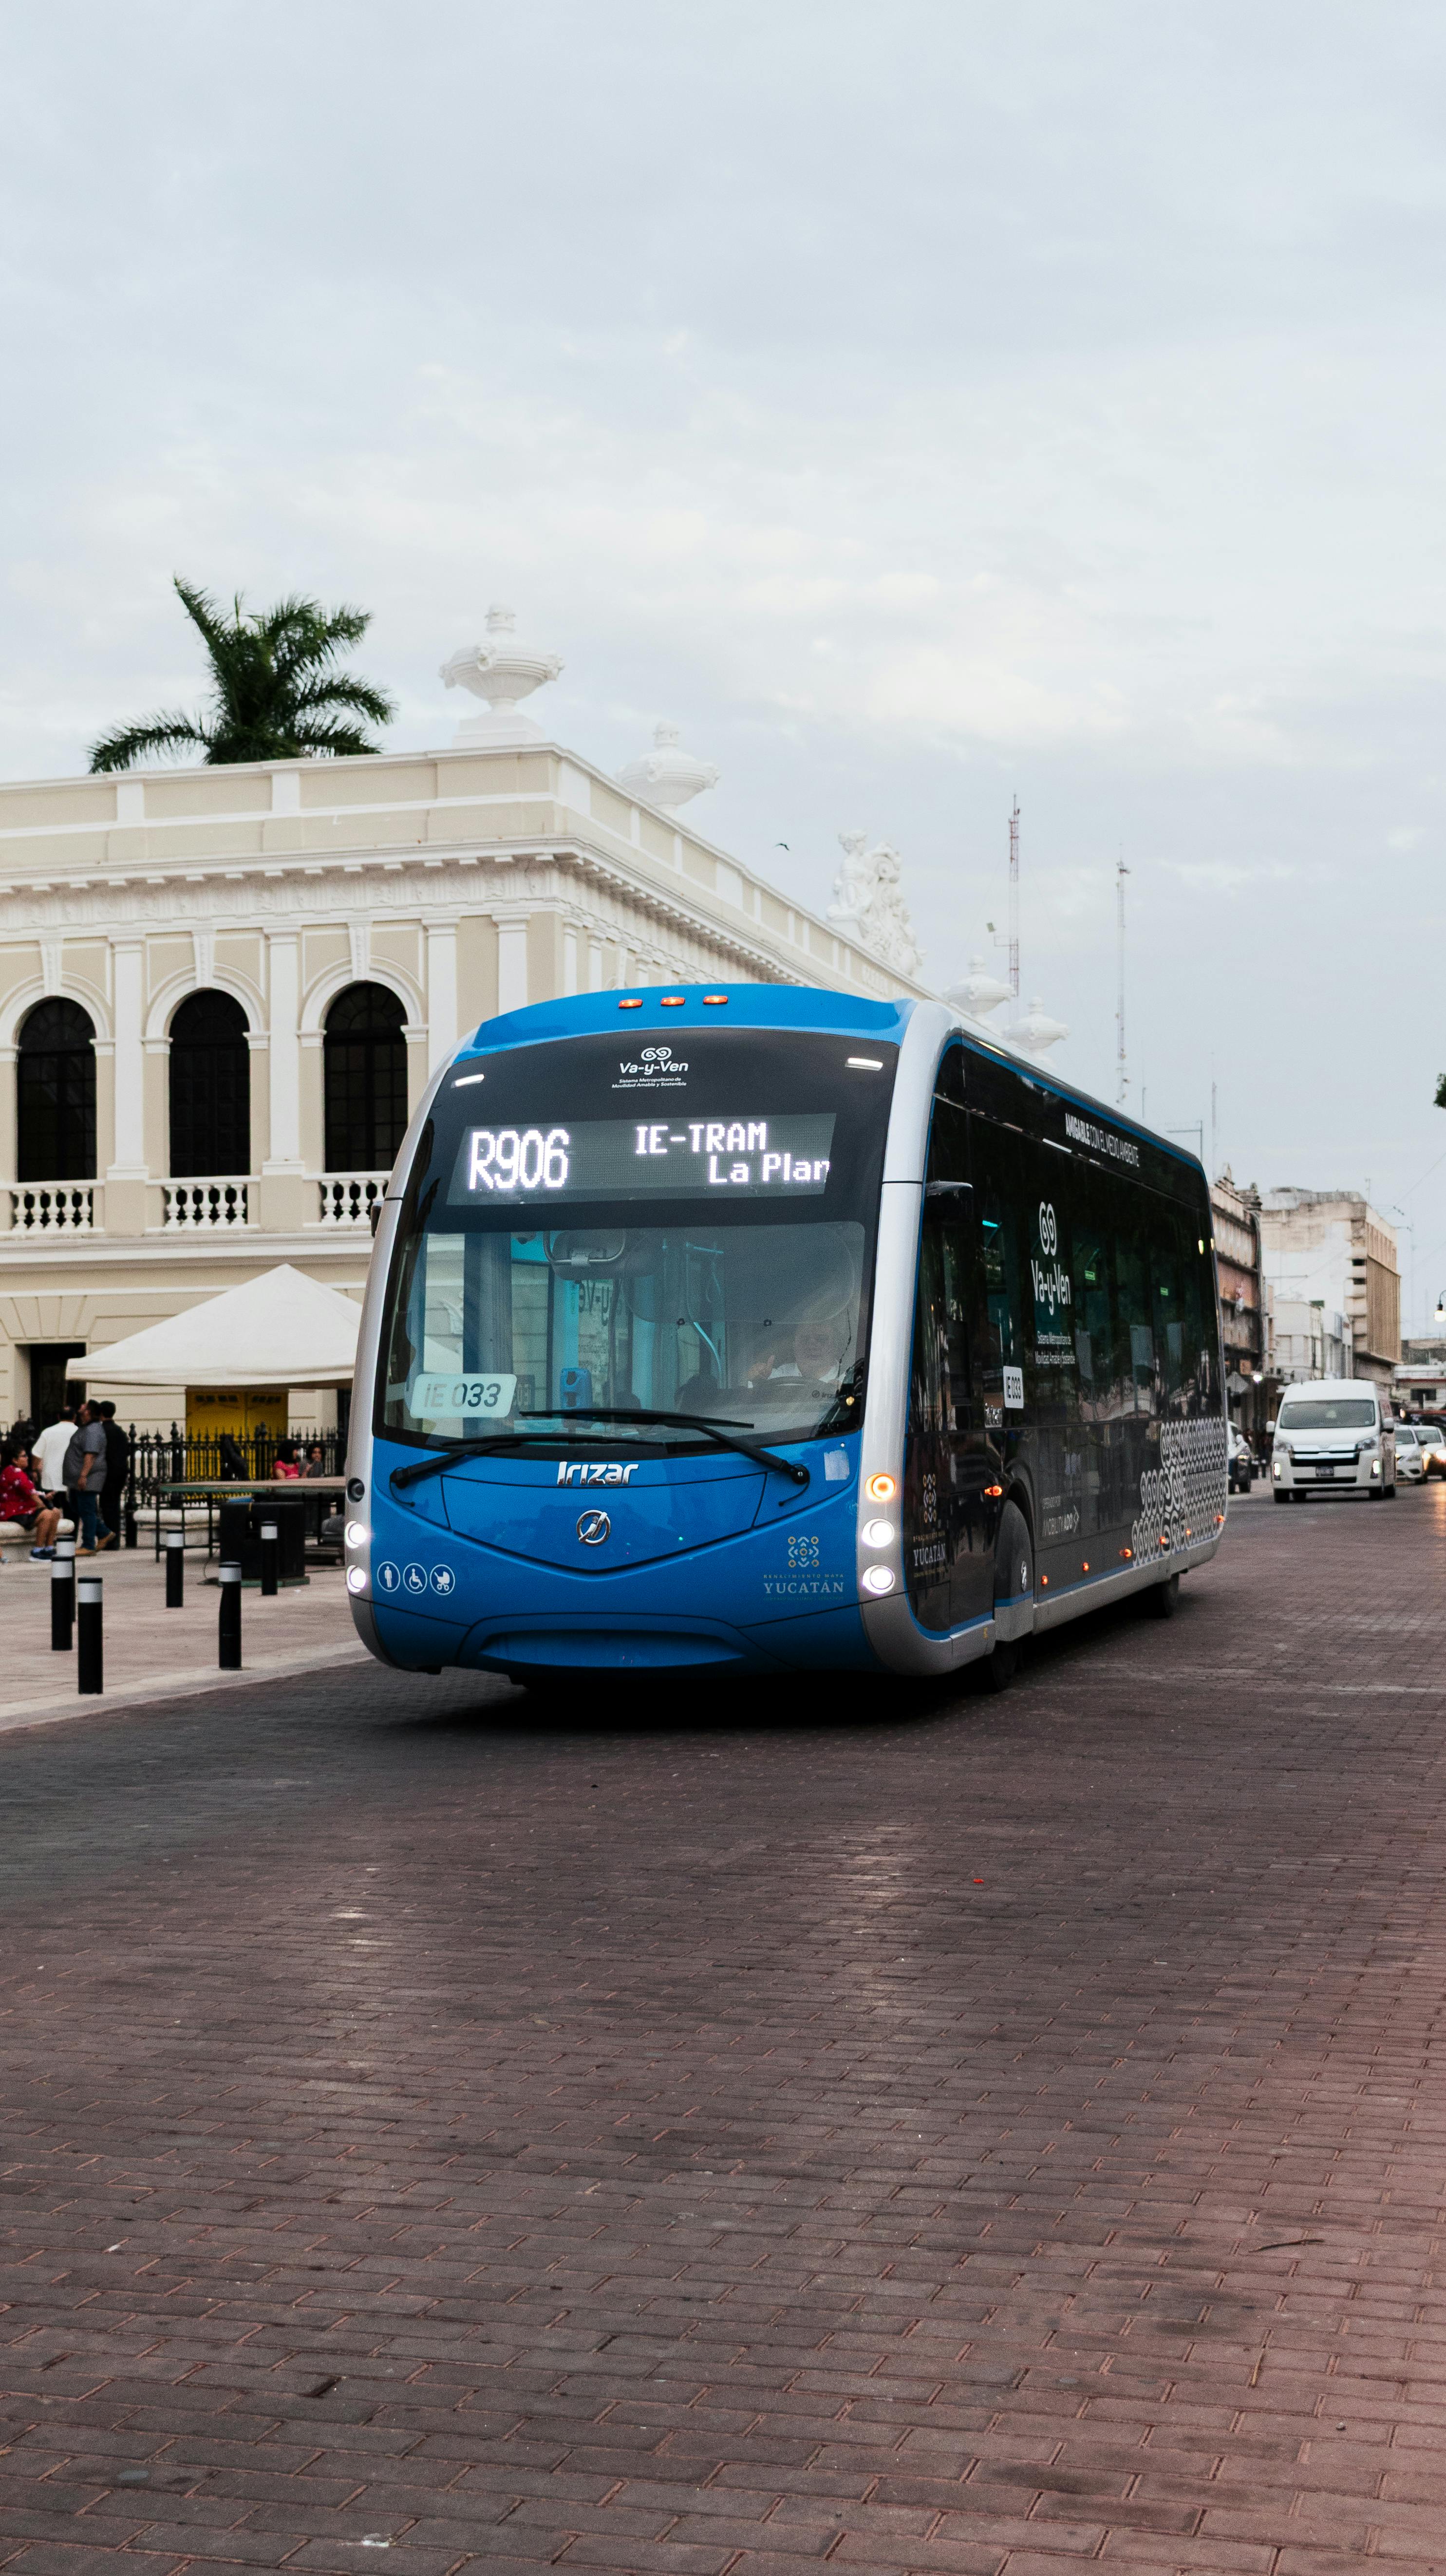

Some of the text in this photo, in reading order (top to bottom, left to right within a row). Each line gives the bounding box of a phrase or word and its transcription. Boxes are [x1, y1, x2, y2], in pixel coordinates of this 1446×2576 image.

[620, 1061, 689, 1075] Va-y-Ven
[636, 1122, 767, 1155] IE-TRAM
[469, 1129, 570, 1190] R906
[709, 1156, 749, 1183] La
[1031, 1259, 1071, 1316] Va-y-Ven
[424, 1383, 448, 1407] IE
[451, 1382, 501, 1408] 033
[1011, 1376, 1021, 1400] 033
[557, 1461, 639, 1485] Irizar
[913, 1540, 946, 1567] YUCATÁN
[763, 1580, 844, 1594] YUCATÁN
